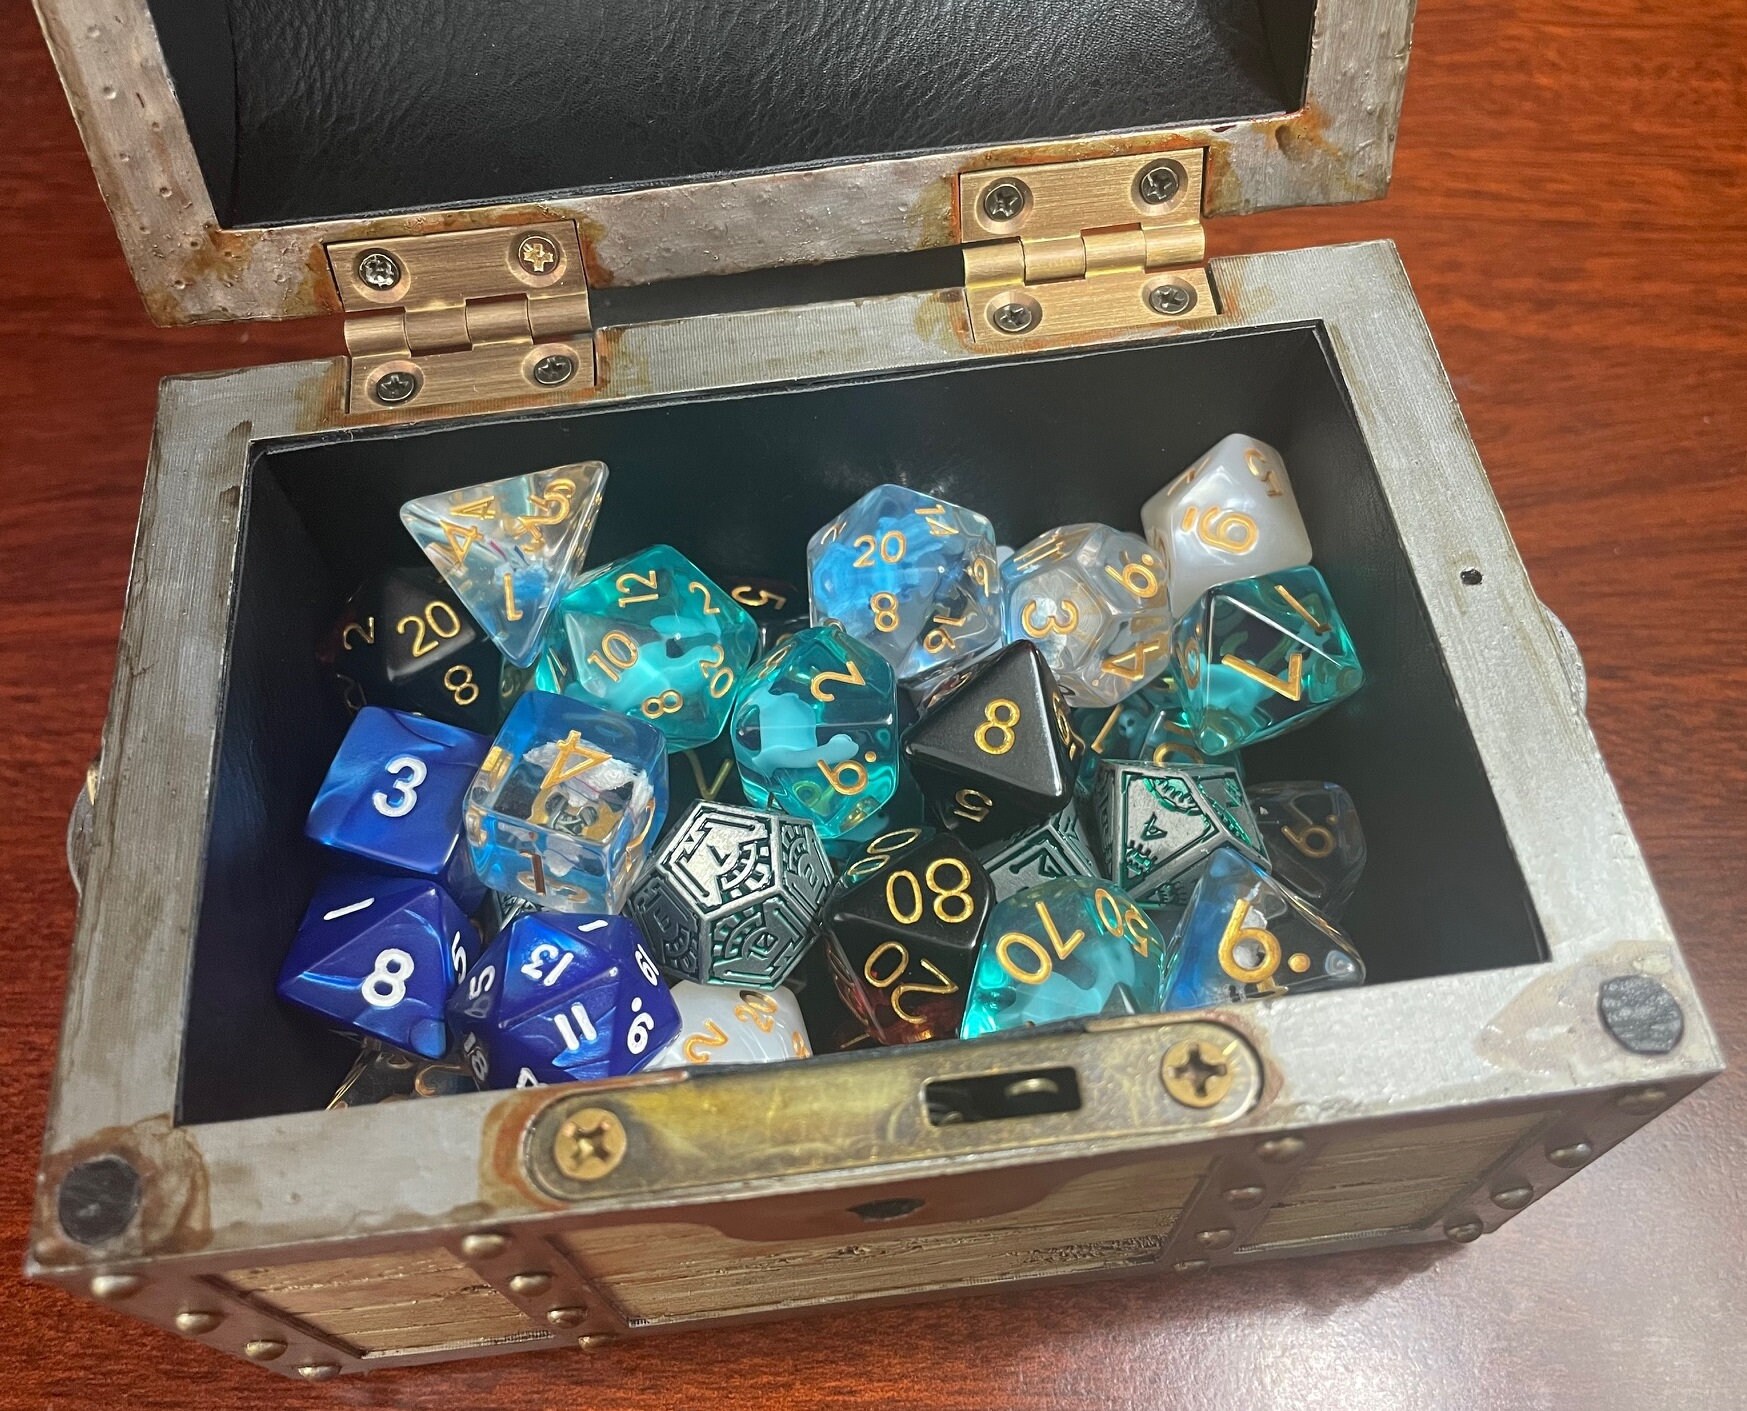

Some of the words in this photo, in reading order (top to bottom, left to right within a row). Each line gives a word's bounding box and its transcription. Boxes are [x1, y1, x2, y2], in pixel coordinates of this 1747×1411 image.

[439, 519, 484, 563] 4
[853, 530, 907, 567] 20
[504, 572, 523, 621] 1
[616, 570, 659, 608] 12
[688, 582, 720, 615] 2
[343, 616, 375, 650] 2
[397, 600, 461, 658] 20
[870, 591, 899, 632] 8
[1021, 599, 1080, 638] 3
[587, 630, 638, 683] 10
[699, 644, 734, 699] 20
[1101, 638, 1161, 682] 4
[1221, 653, 1303, 702] 7
[443, 664, 479, 705] 8
[810, 661, 866, 702] 2
[641, 689, 684, 719] 8
[973, 698, 1021, 755] 8
[540, 729, 614, 790] 4
[372, 753, 429, 818] 3
[361, 948, 416, 1008] 8
[451, 931, 468, 983] 5
[521, 943, 575, 988] 13
[553, 1001, 598, 1051] 11
[684, 1019, 728, 1063] 2
